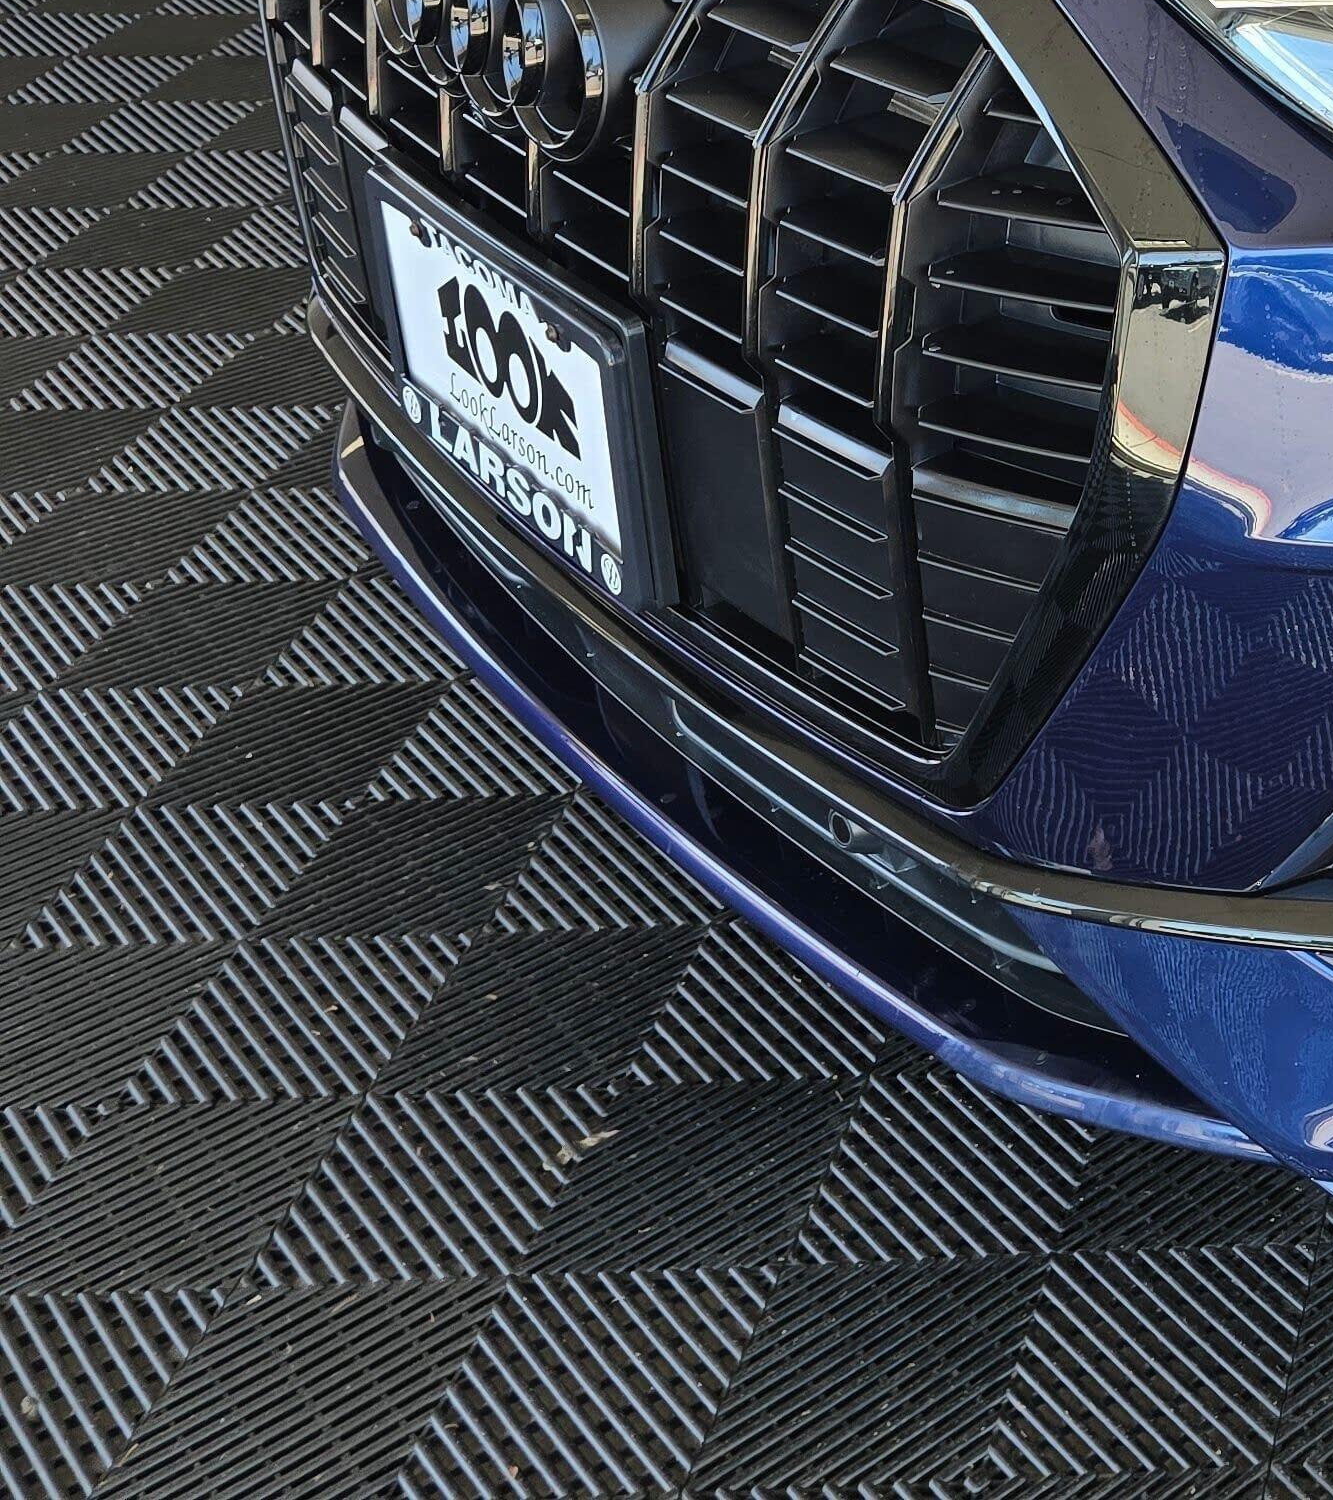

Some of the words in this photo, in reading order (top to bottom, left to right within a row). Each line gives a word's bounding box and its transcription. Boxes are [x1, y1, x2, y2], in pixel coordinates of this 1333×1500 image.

[420, 218, 540, 323] TACOMA
[438, 276, 582, 462] LOOK
[450, 373, 595, 510] LookLarson.com
[430, 401, 592, 573] LARSON
